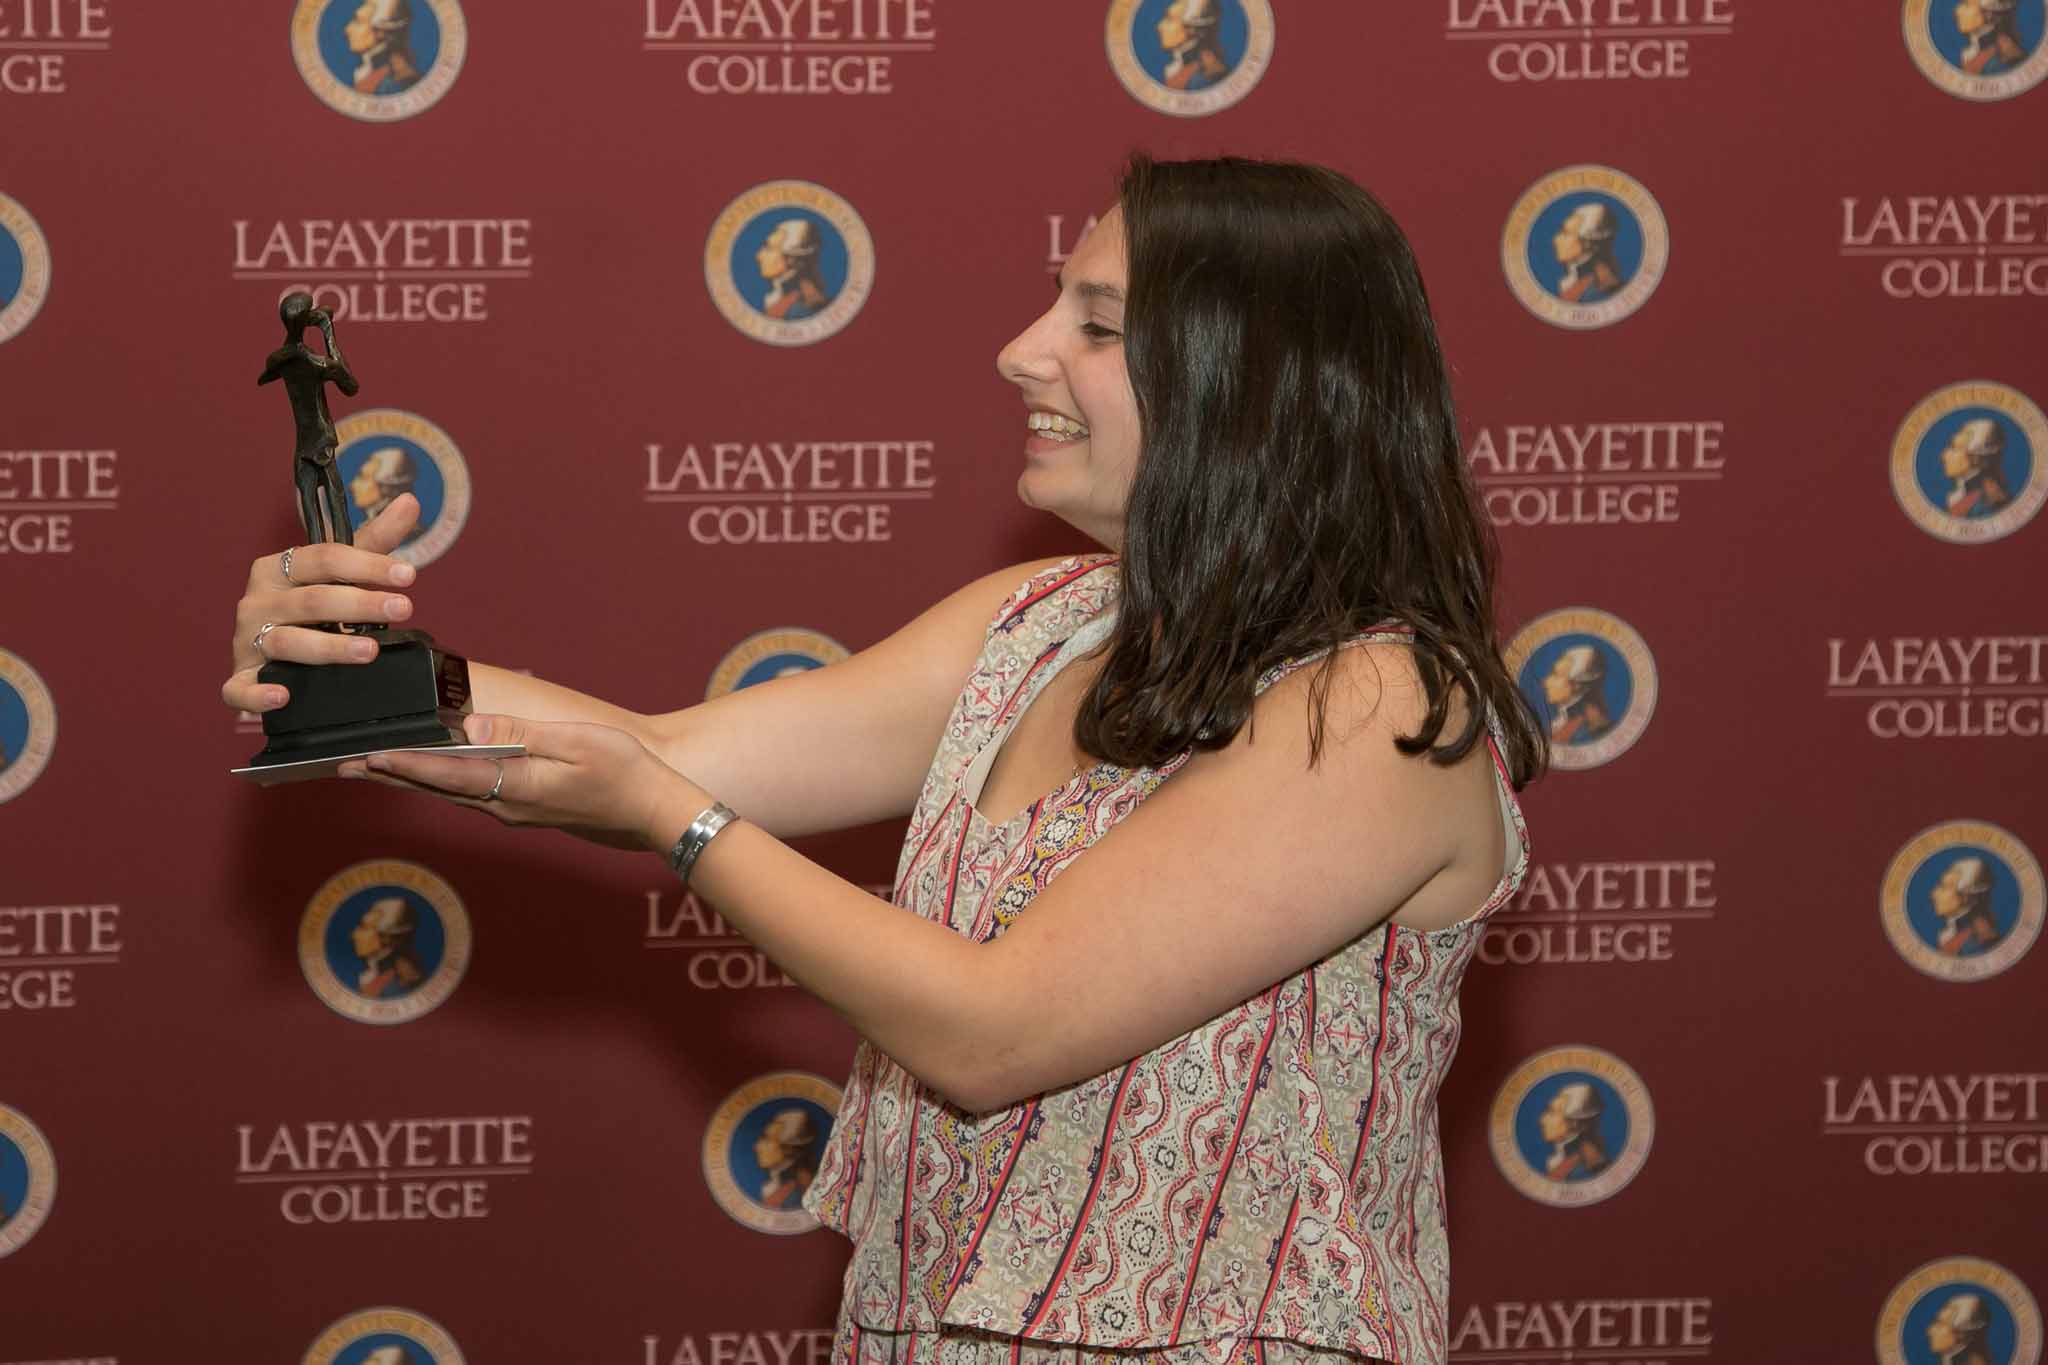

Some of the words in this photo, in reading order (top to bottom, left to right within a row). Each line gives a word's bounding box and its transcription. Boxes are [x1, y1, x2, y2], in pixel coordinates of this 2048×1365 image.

[645, 0, 937, 39] LAFAYETTE
[687, 55, 893, 94] COLLEGE
[1487, 40, 1690, 82] COLLEGE
[233, 219, 532, 268] LAFAYETTE
[645, 441, 936, 491] LAFAYETTE
[1466, 421, 1726, 473] AFAYETTE
[688, 504, 892, 544] COLLEGE
[1484, 484, 1680, 526] COLLEGE
[1868, 698, 2048, 738] COLLEG
[1503, 861, 1718, 912] AYETTE
[1477, 923, 1674, 965] COLLEGE
[236, 1116, 533, 1172] LAFAYETTE
[280, 1181, 489, 1224] COLLEGE
[1448, 1297, 1713, 1350] AFAYETTE
